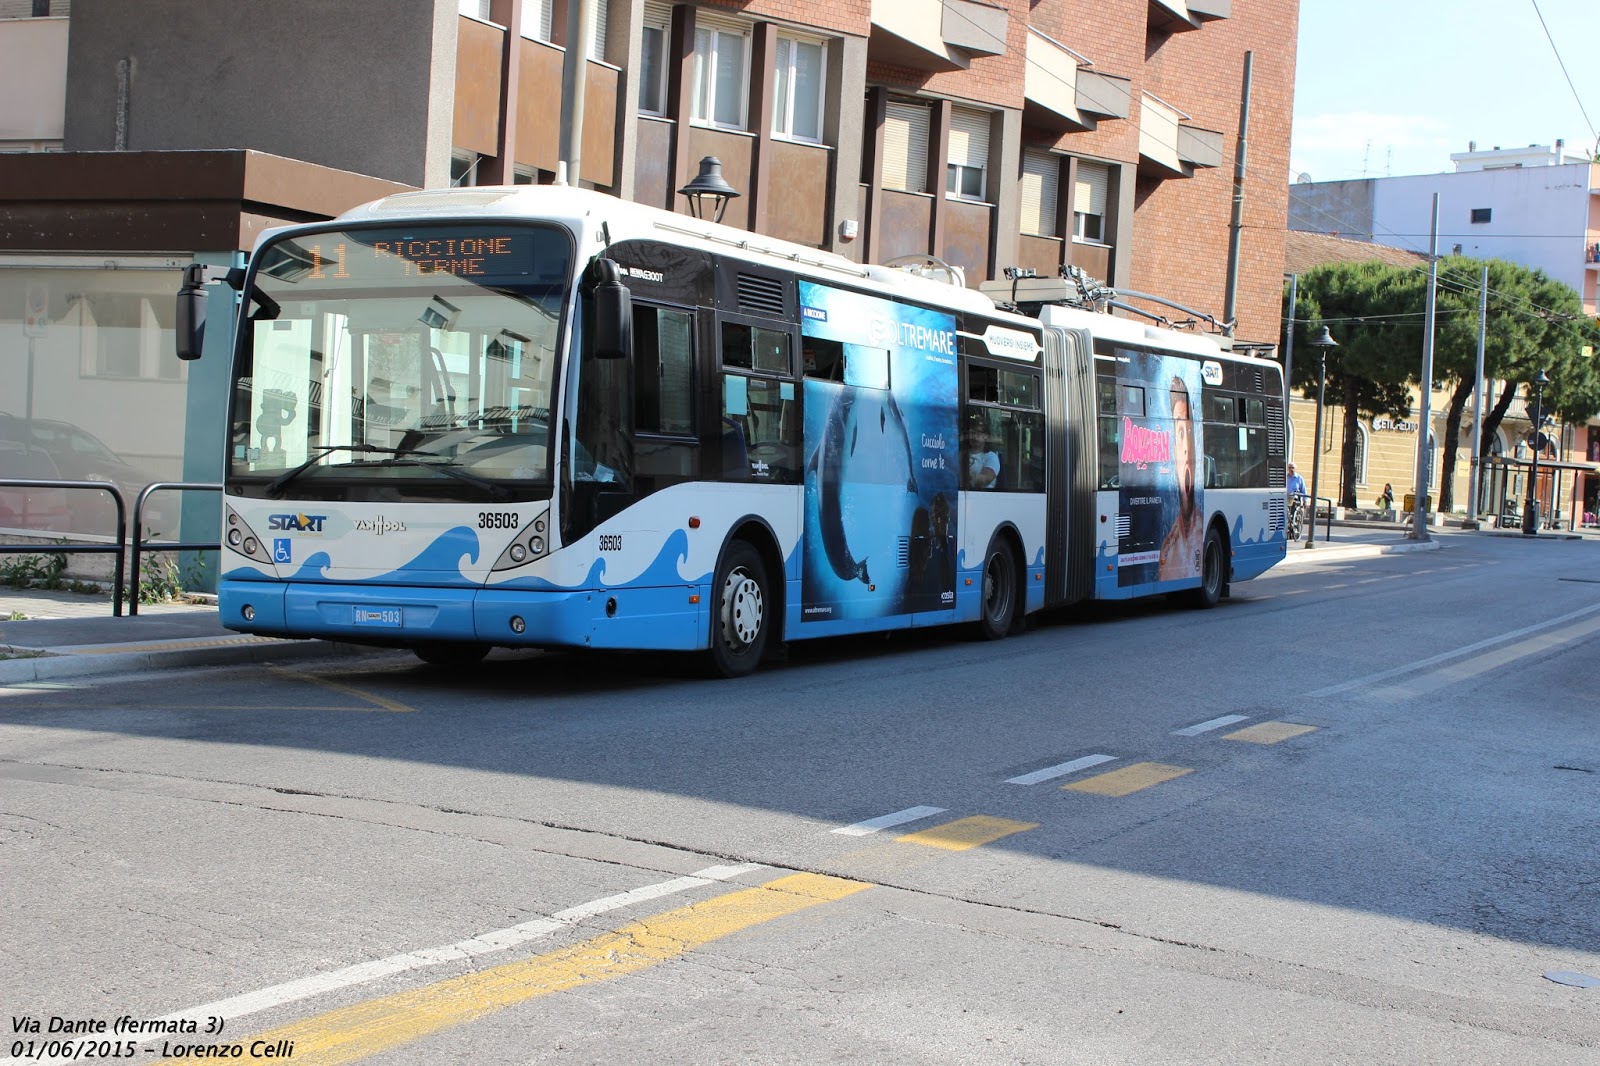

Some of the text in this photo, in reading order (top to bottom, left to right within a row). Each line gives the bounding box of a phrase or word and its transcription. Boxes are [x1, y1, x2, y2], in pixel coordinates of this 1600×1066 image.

[308, 238, 512, 279] 11 RICCIONE
[403, 258, 485, 276] TERME
[889, 320, 954, 356] OLTREMARE
[988, 335, 1034, 352] MUOVERSI INSIEME
[921, 432, 946, 450] Cucciolo
[921, 453, 946, 470] come te
[268, 512, 327, 532] START
[478, 512, 519, 529] 36503
[599, 535, 622, 551] 36503
[355, 609, 367, 622] RN
[382, 610, 400, 623] 503
